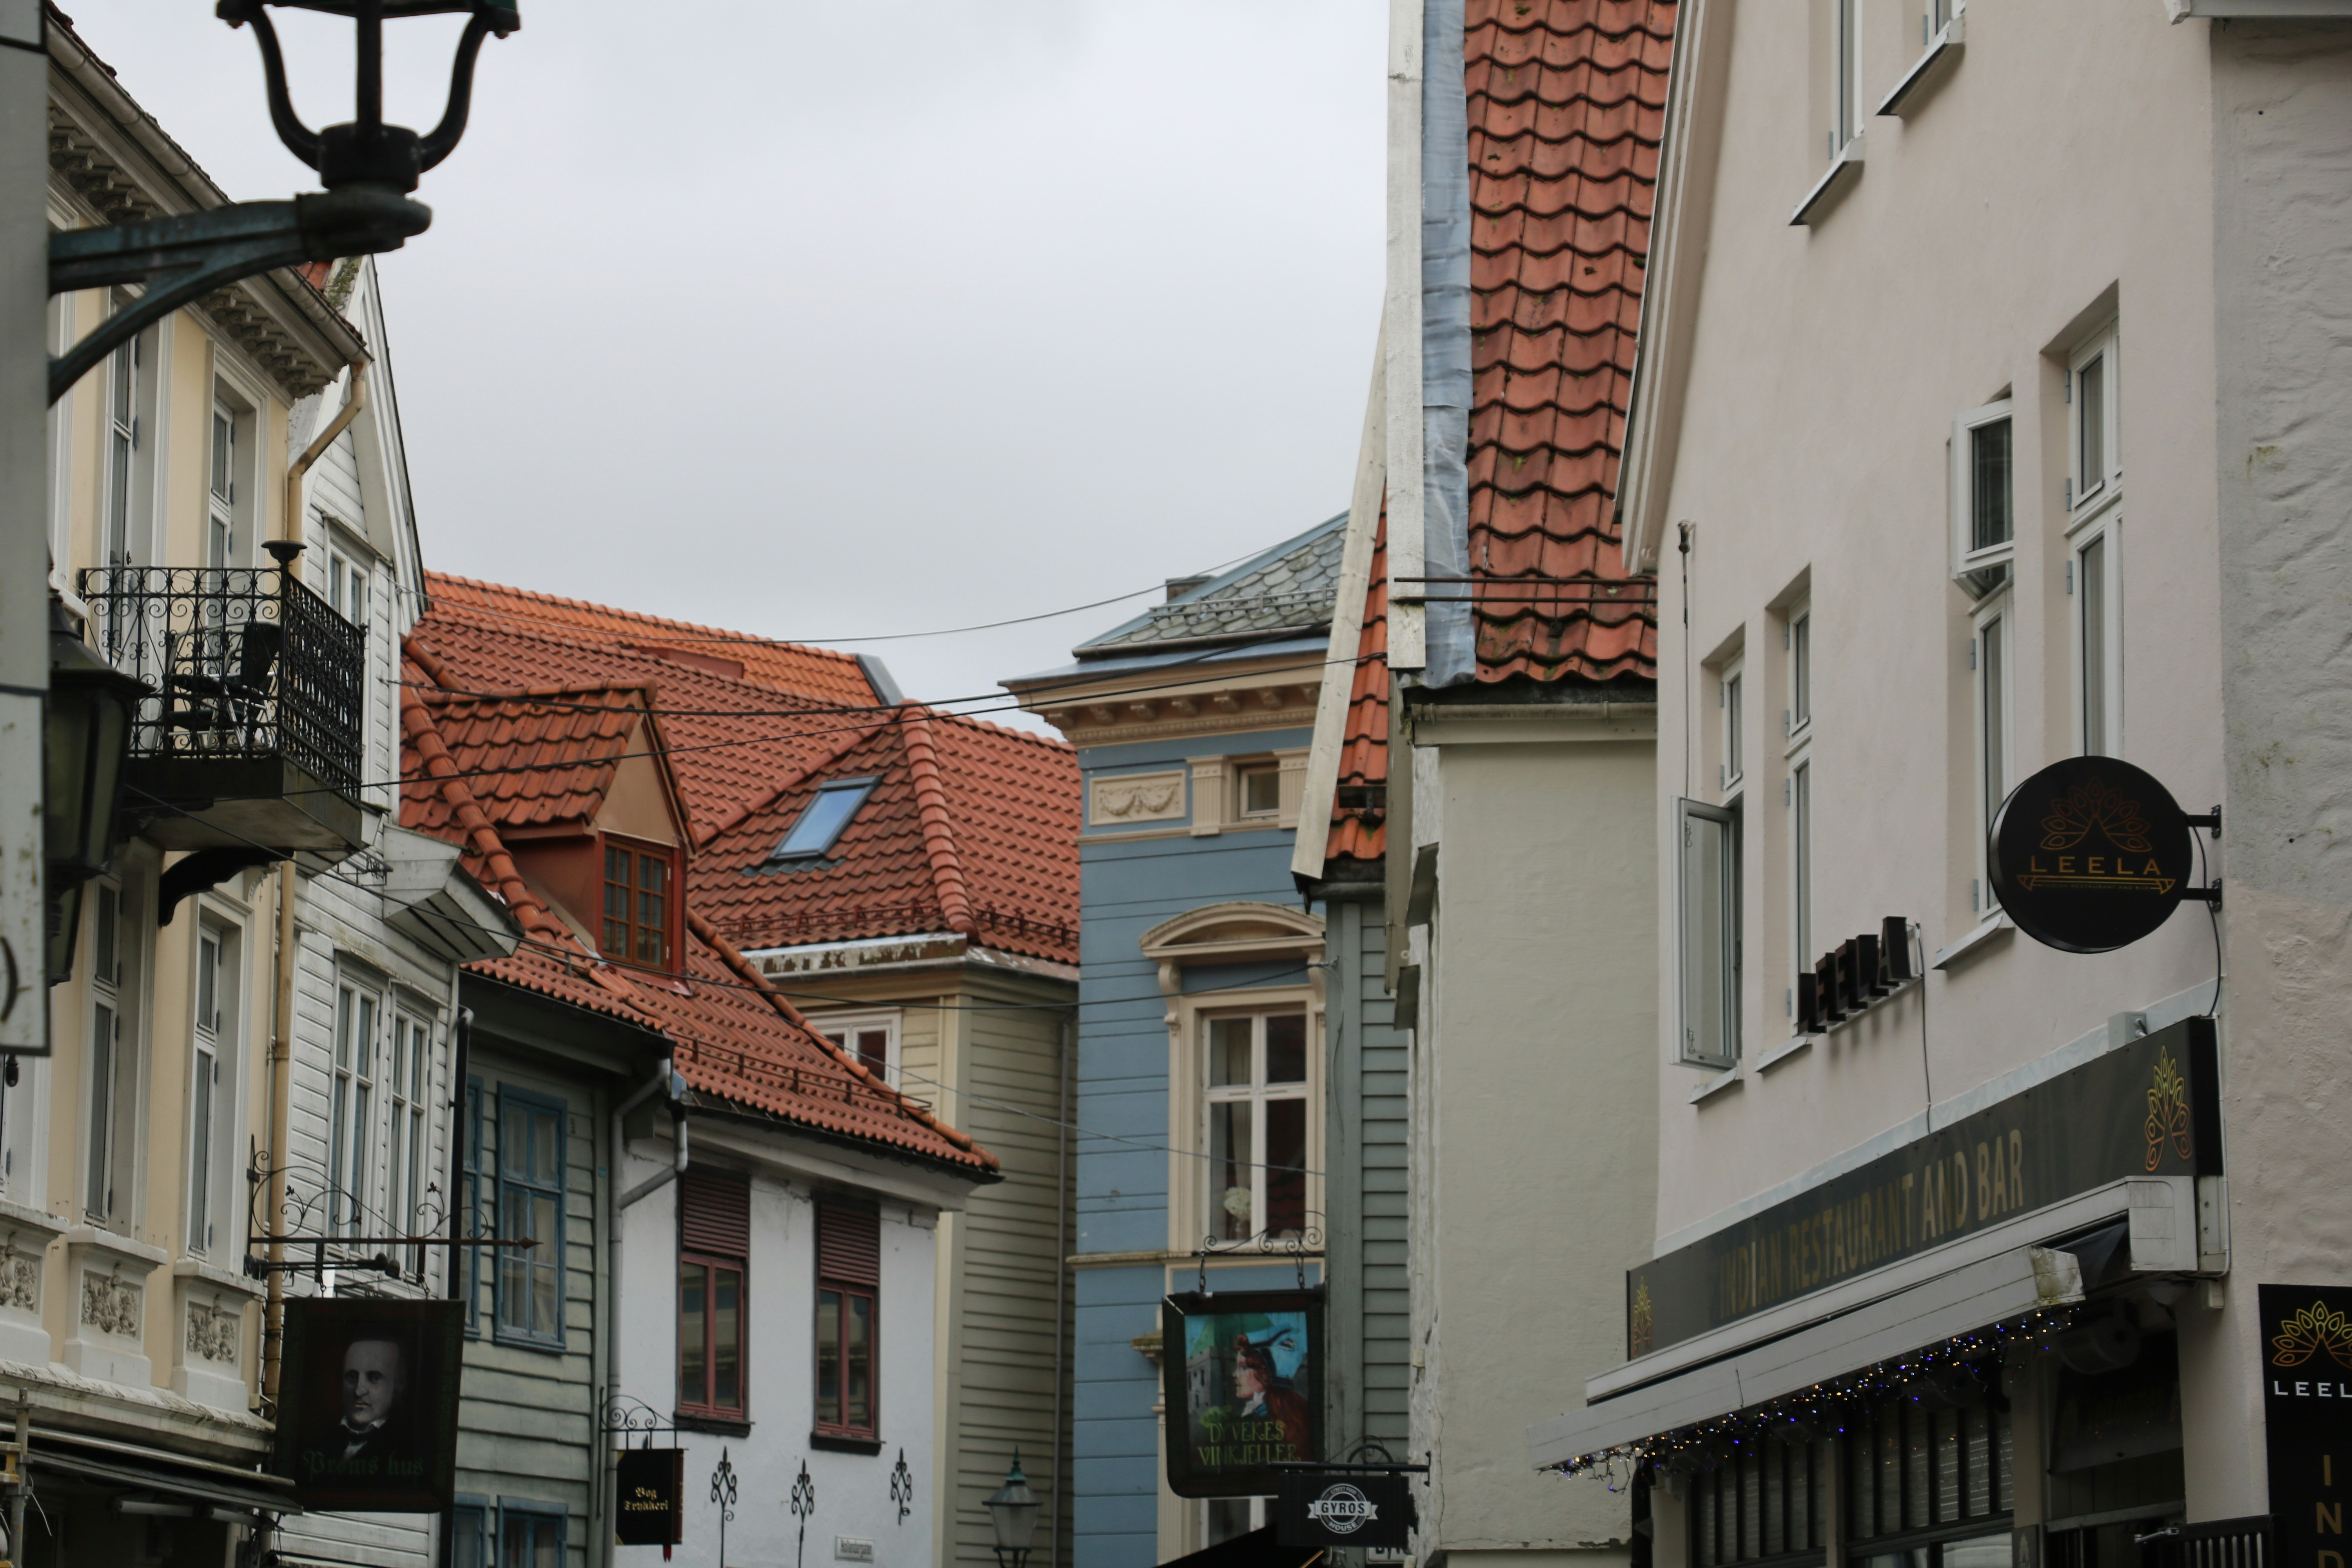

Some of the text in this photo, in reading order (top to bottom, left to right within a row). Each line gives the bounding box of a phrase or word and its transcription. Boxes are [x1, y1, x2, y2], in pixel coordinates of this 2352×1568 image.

[2031, 855, 2161, 875] LEELA
[1720, 1129, 2024, 1319] INDIAN RESTAURANT AND BAR
[1330, 1486, 1357, 1495] STREET FOOD
[1321, 1502, 1365, 1514] GYROS
[1329, 1521, 1358, 1532] HOUSE
